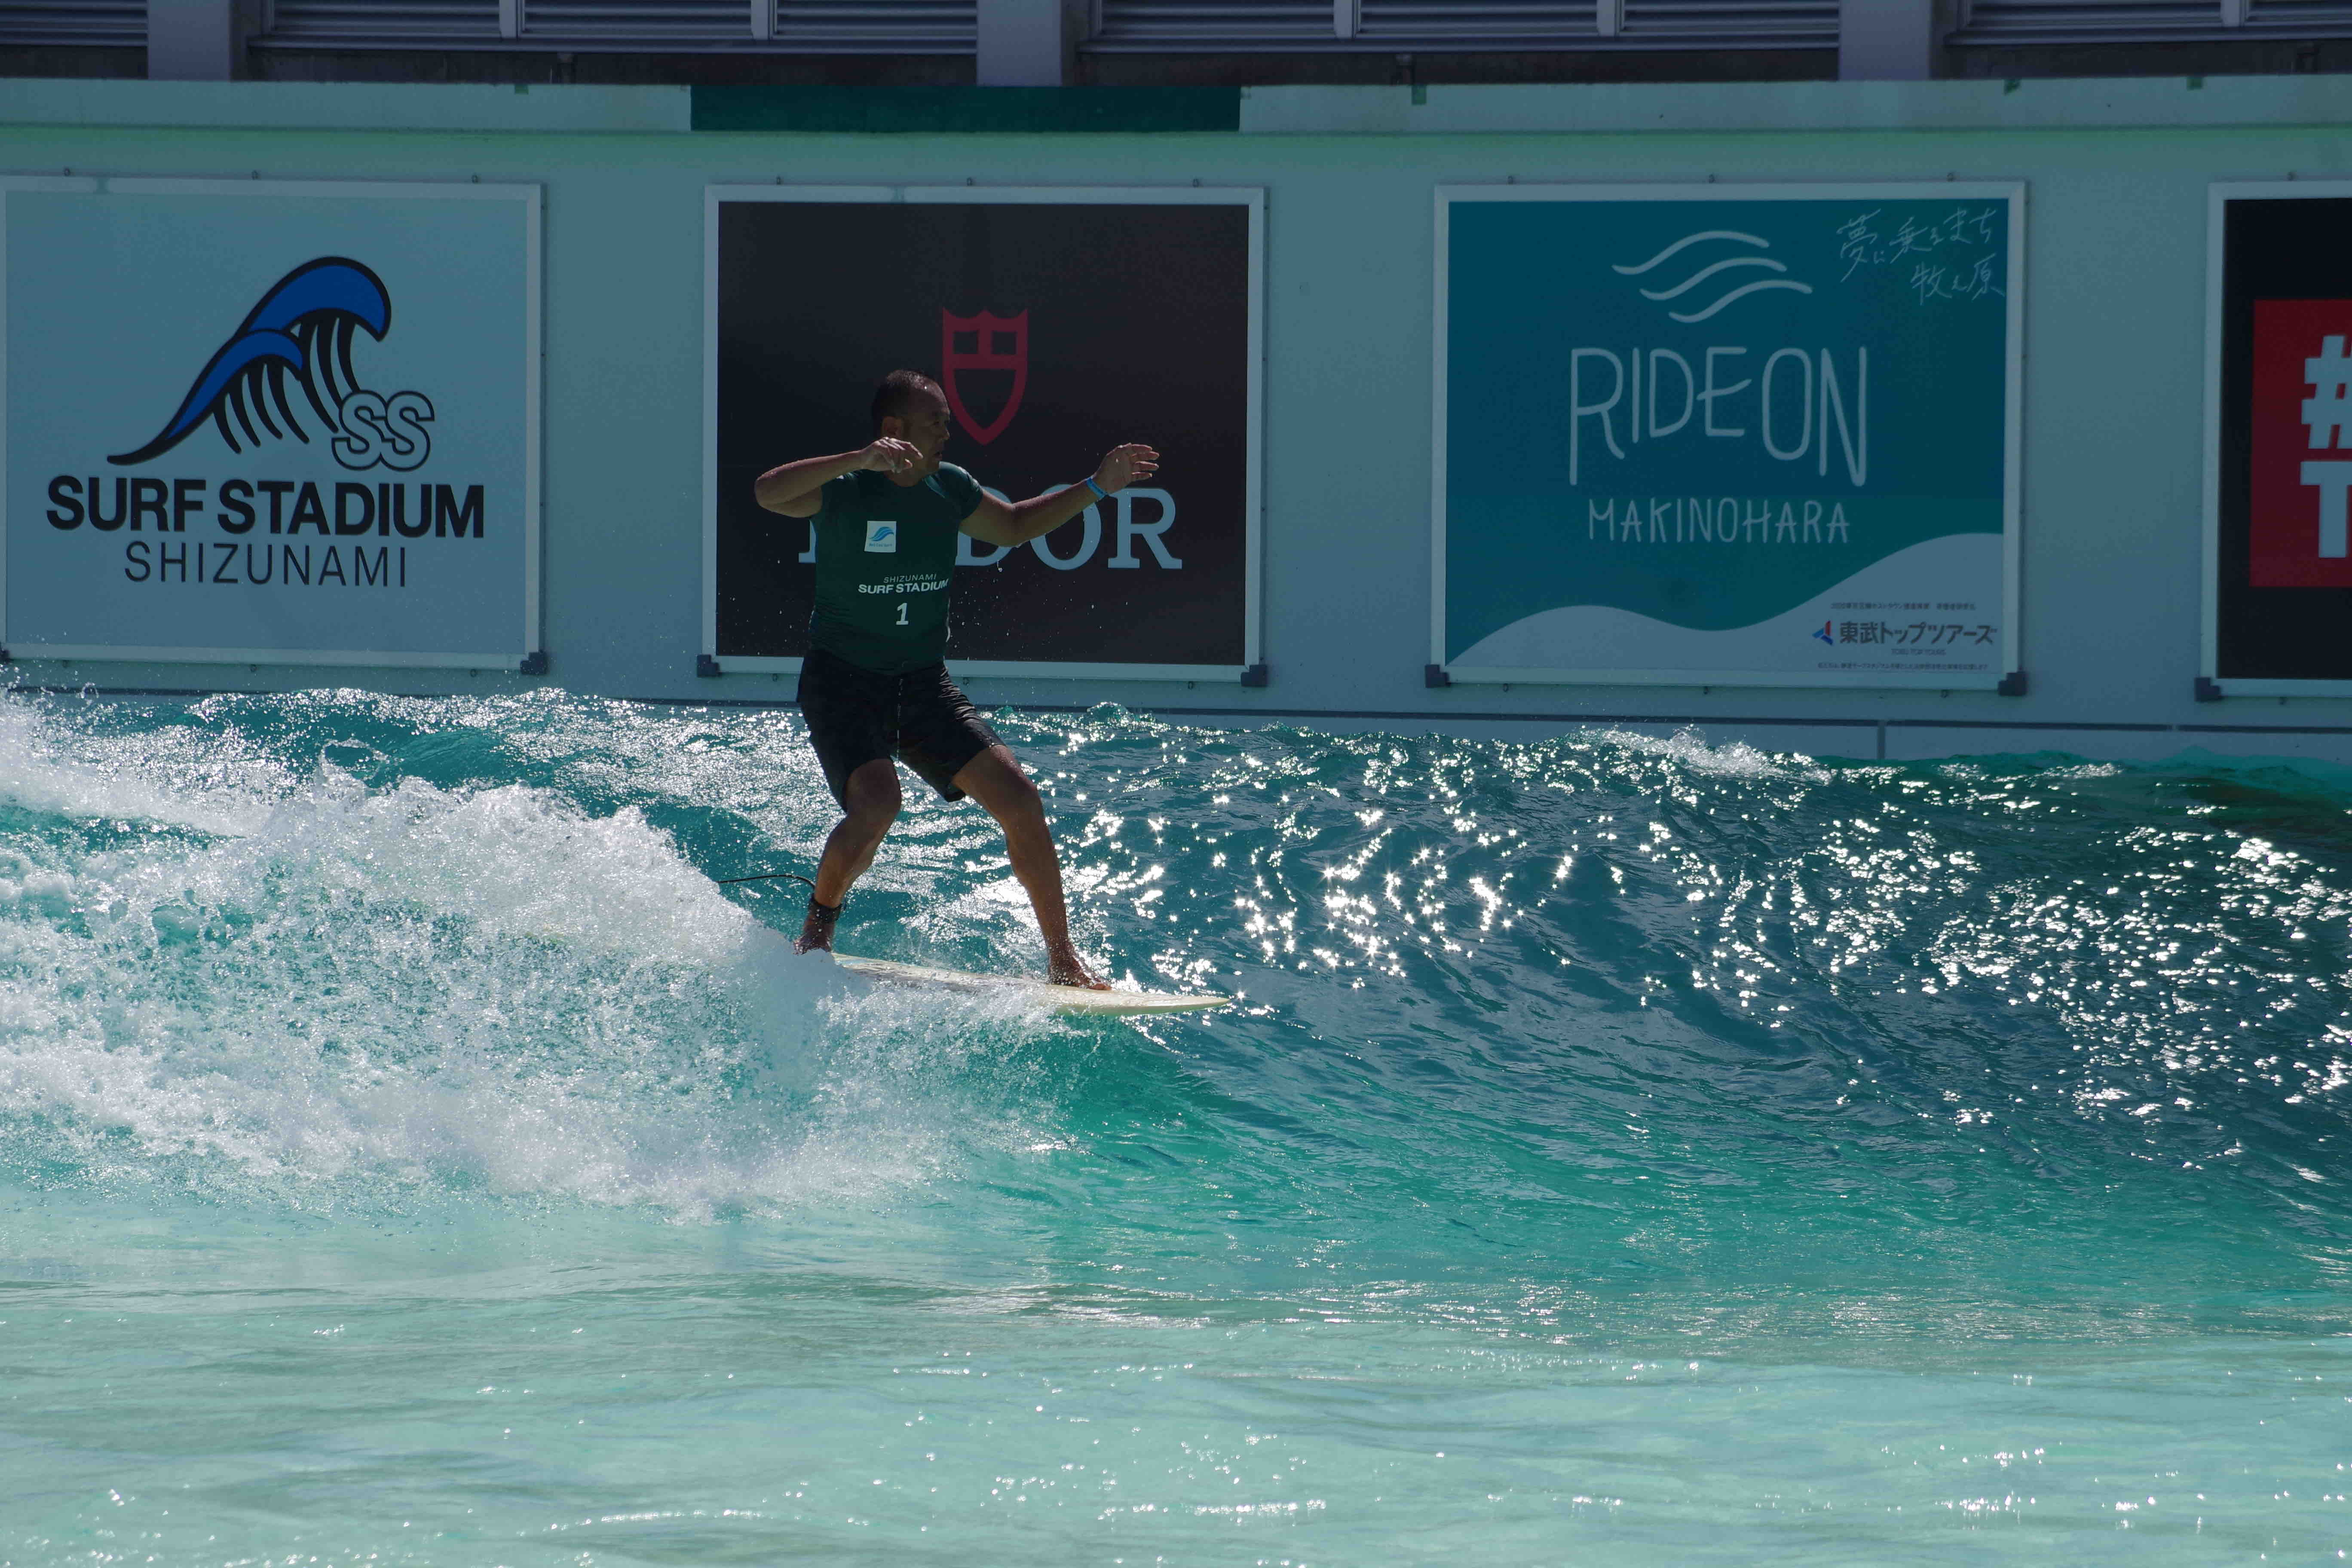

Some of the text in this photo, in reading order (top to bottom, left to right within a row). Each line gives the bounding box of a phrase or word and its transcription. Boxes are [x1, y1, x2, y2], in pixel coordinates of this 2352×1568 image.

[331, 390, 435, 472] SS
[47, 475, 484, 538] SURF STADIUM
[1589, 497, 1850, 543] MAKINOHARA
[125, 541, 406, 587] SHIZUNAMI
[883, 574, 937, 583] SHIZUNAMI
[858, 584, 894, 594] SURF
[896, 603, 909, 625] 1
[1839, 621, 1997, 644] 東武トップツアーズ
